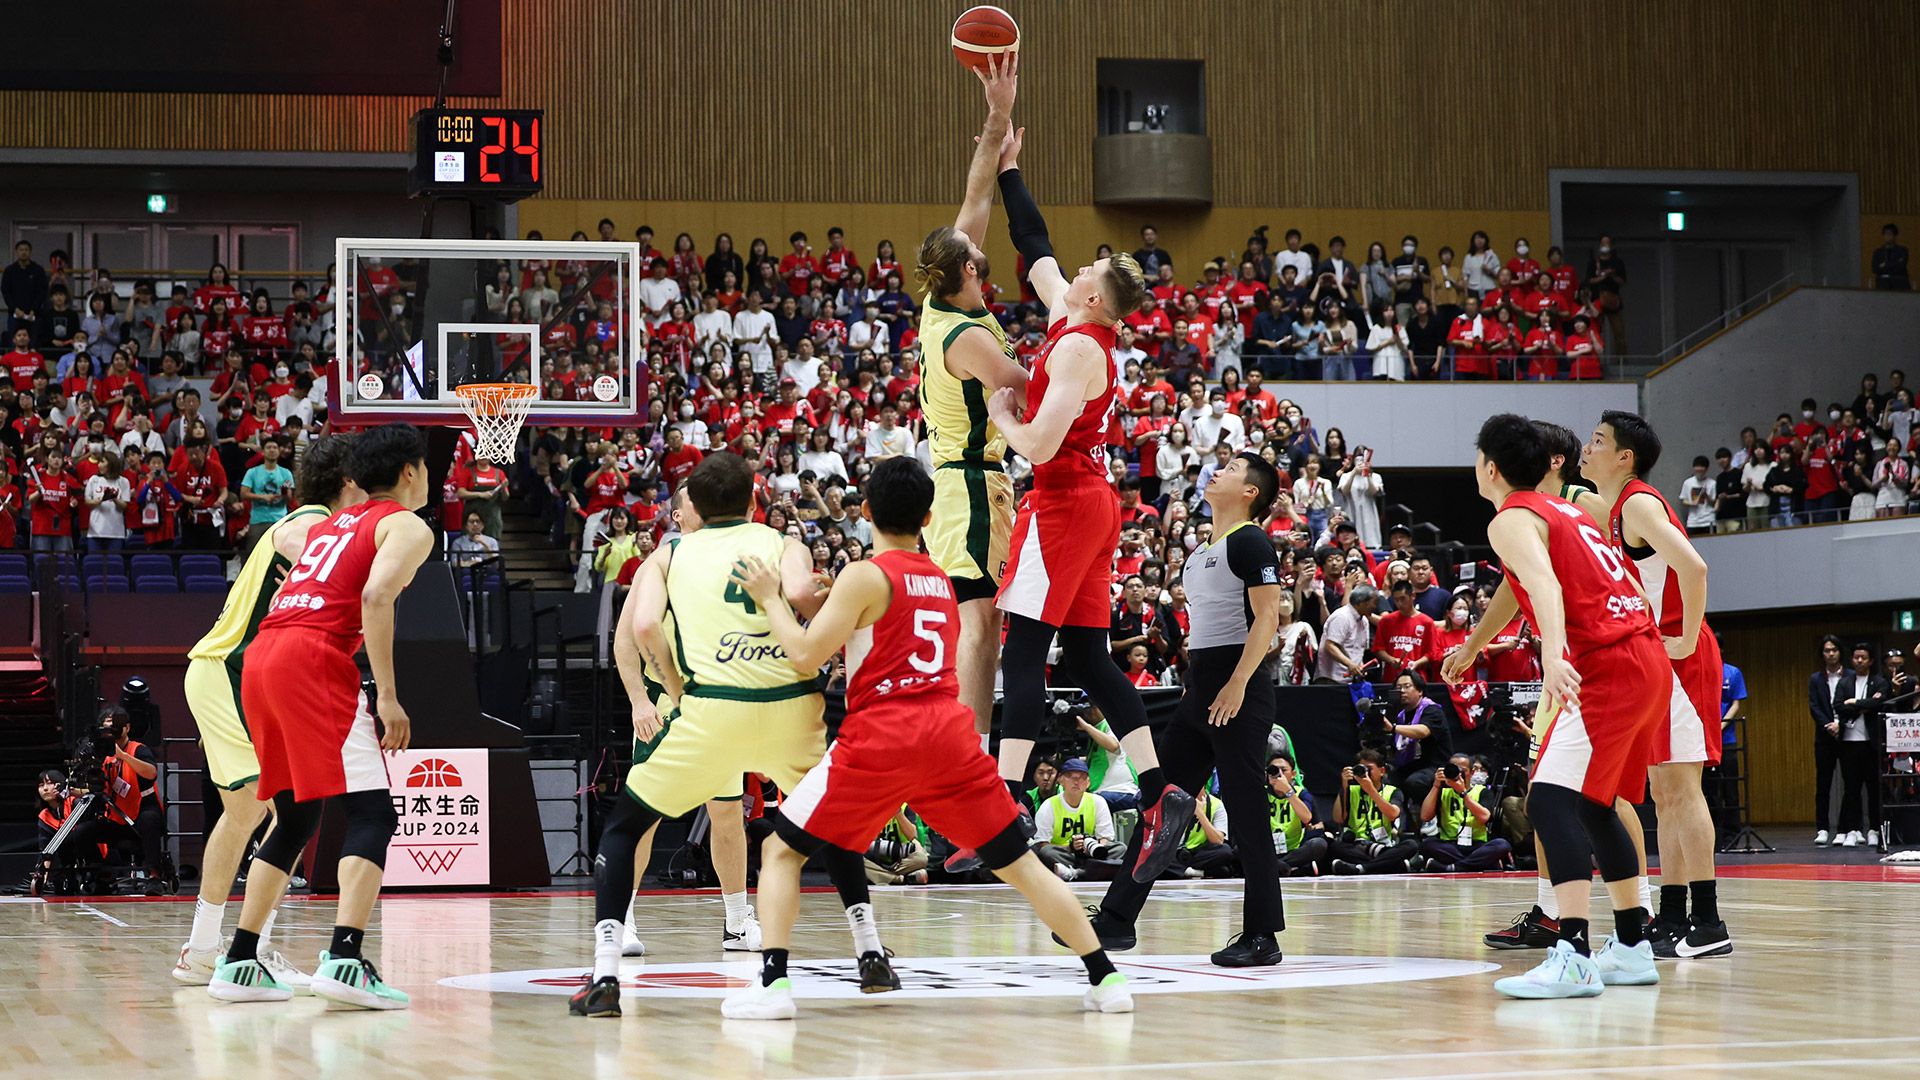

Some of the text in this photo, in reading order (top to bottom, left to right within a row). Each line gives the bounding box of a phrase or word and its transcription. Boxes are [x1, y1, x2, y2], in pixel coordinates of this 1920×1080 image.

[438, 116, 473, 142] 10:00
[480, 117, 539, 183] 24
[290, 531, 355, 584] 91
[1578, 524, 1625, 582] 6
[278, 593, 326, 611] 日本生命
[723, 560, 757, 614] 4
[904, 574, 951, 600] KAWAMURA
[908, 608, 947, 675] 5
[391, 794, 480, 817] 日本生命
[393, 822, 480, 837] CUP 2024
